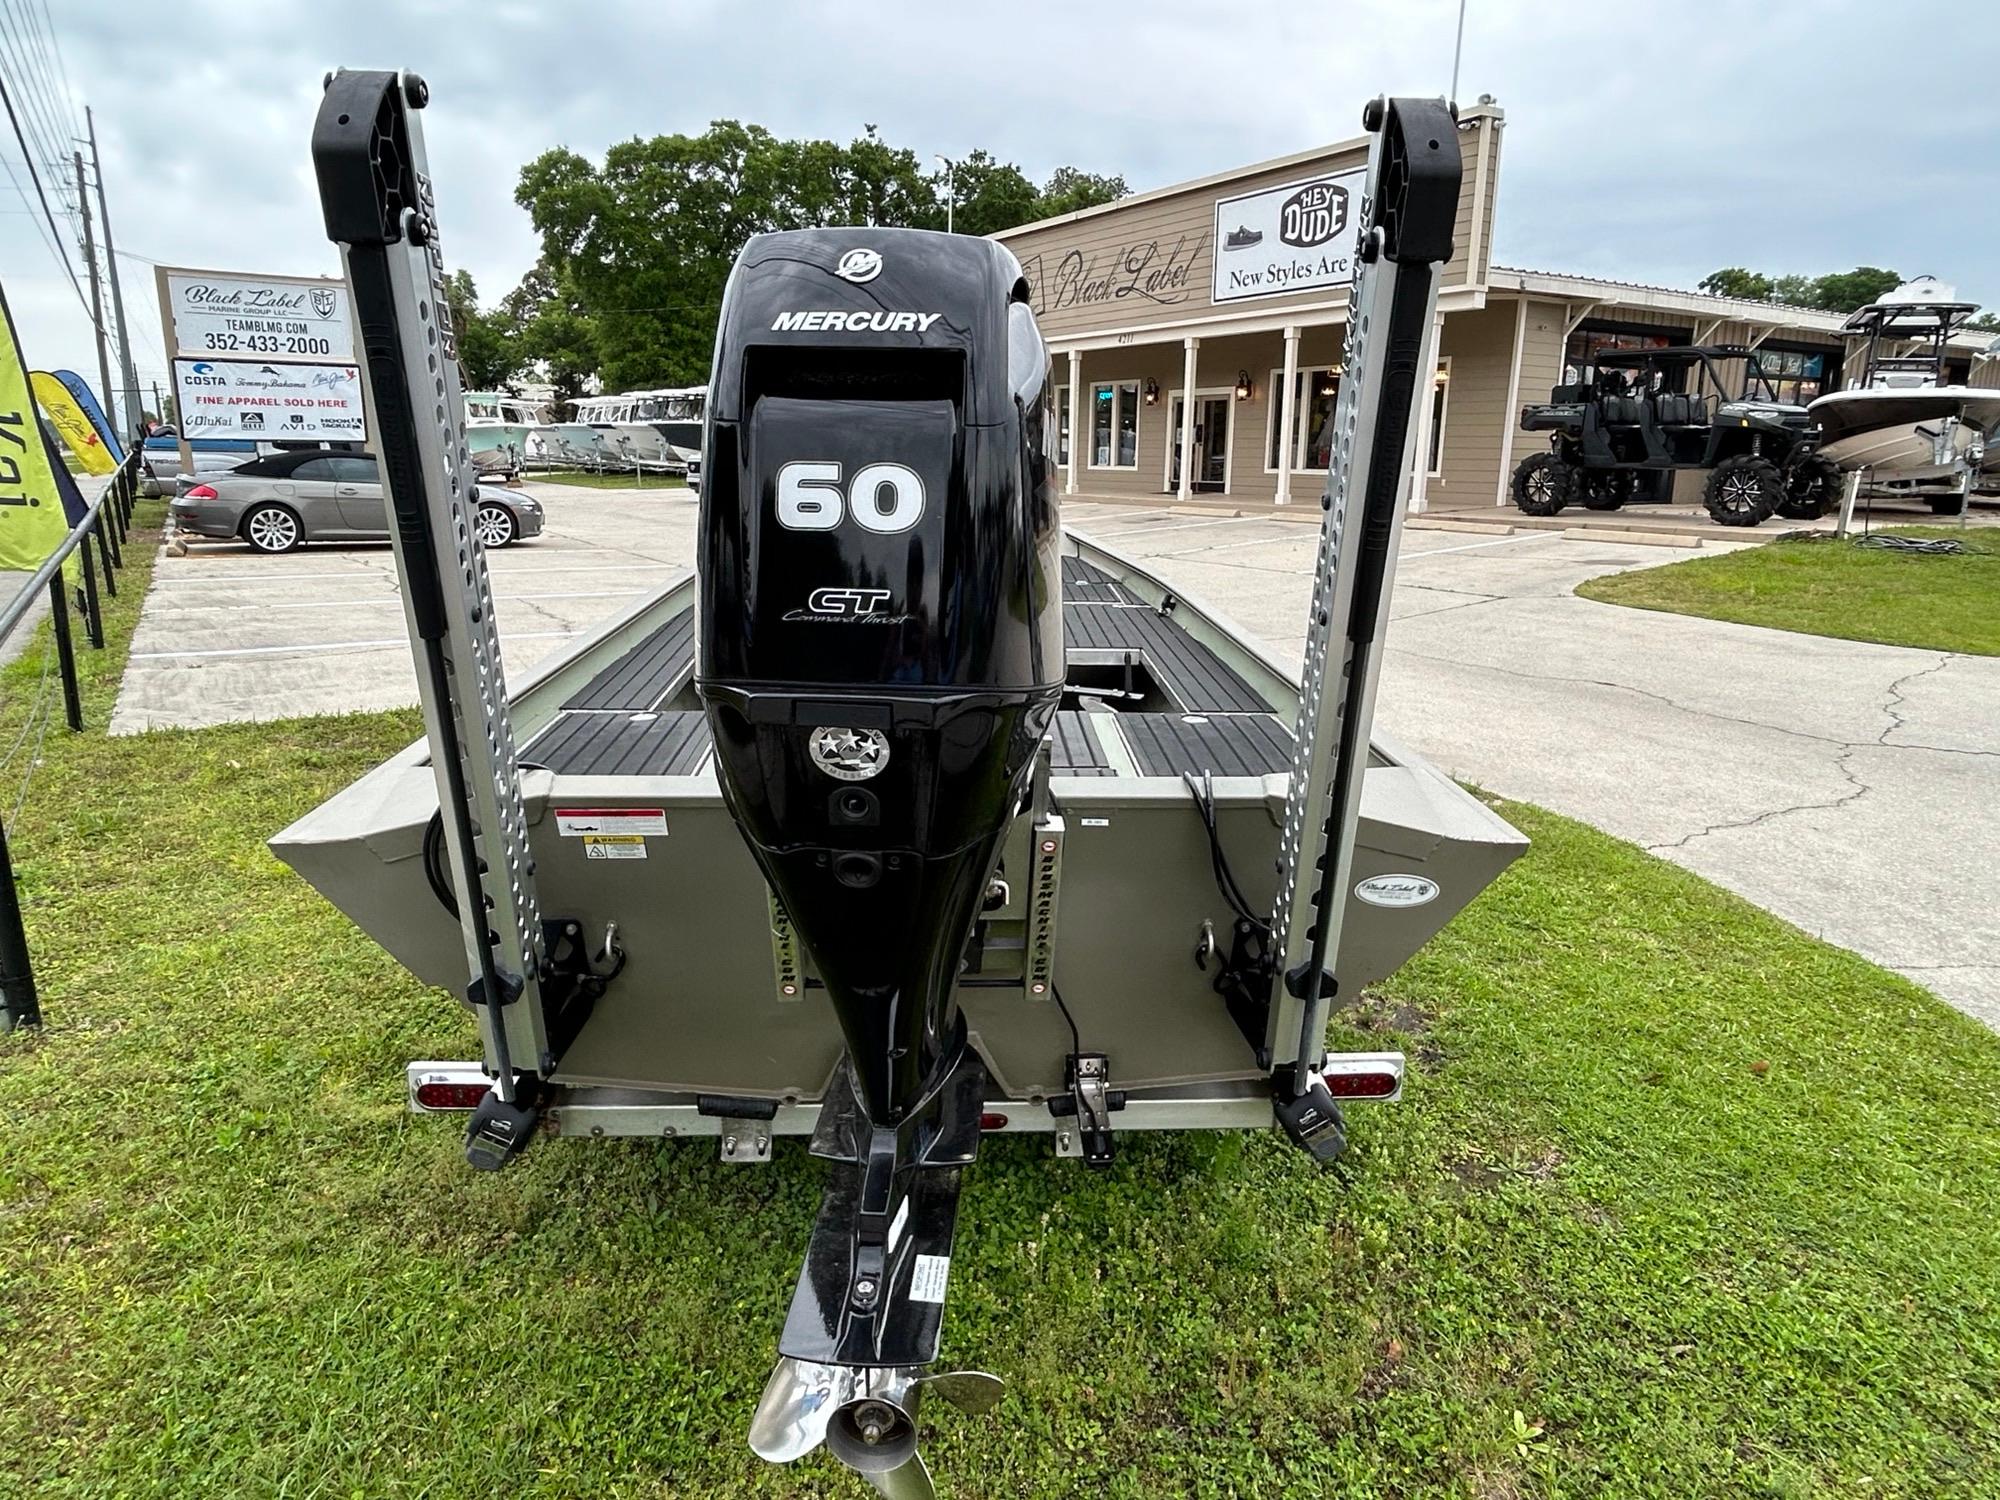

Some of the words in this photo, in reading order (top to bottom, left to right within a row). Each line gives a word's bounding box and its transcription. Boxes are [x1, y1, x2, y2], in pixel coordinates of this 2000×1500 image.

[1300, 183, 1333, 209] HEY
[1285, 194, 1347, 244] DUDE
[1053, 246, 1125, 309] Black
[1115, 231, 1209, 305] Label
[1229, 268, 1264, 290] New
[1266, 261, 1312, 287] Styles
[1317, 256, 1348, 277] Are
[185, 285, 242, 304] Black
[244, 289, 306, 309] Label
[208, 305, 240, 313] MARINE
[243, 307, 271, 315] GROUP
[225, 319, 308, 335] TEAMBLMG.COM
[770, 311, 942, 333] MERCURY
[205, 333, 330, 355] 352-433-2000
[185, 376, 227, 386] COSTA
[235, 378, 268, 390] Tommy
[268, 380, 306, 389] Bahama
[196, 396, 224, 405] FINE
[228, 397, 279, 407] APPAREL
[284, 398, 314, 408] SOLD
[318, 399, 348, 408] HERE
[280, 423, 316, 431] AVID
[775, 460, 926, 534] 60
[782, 609, 857, 624] Command
[860, 611, 915, 624] Thrust
